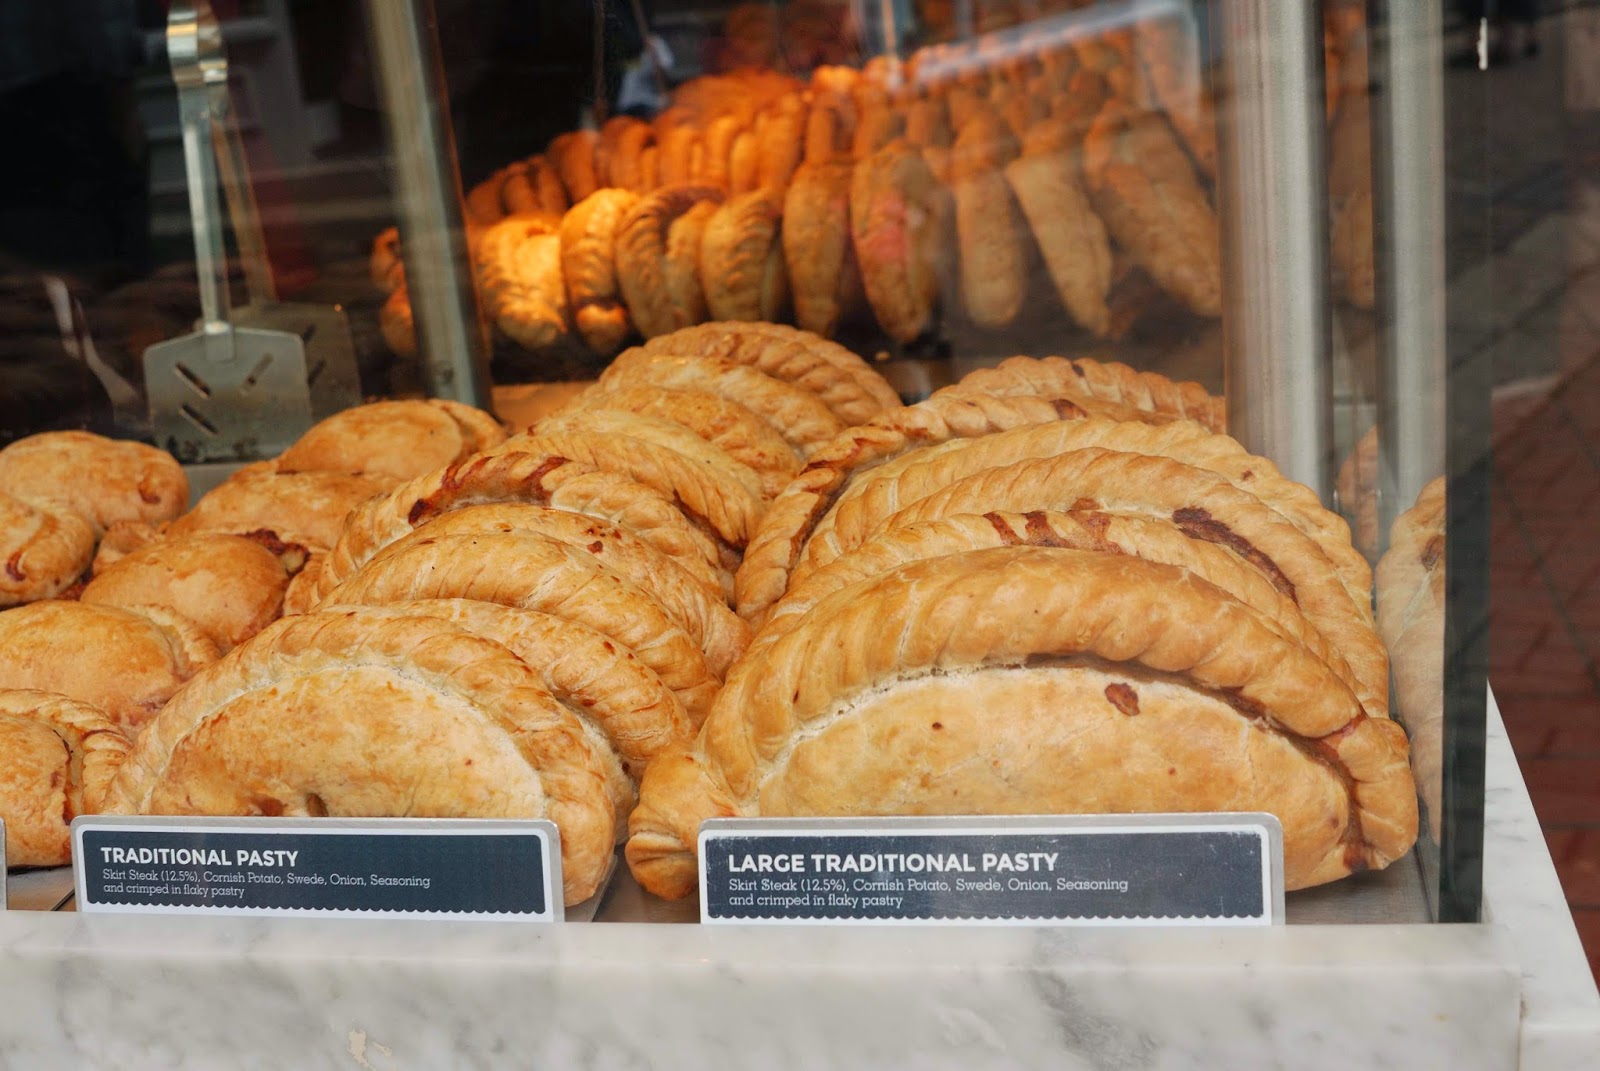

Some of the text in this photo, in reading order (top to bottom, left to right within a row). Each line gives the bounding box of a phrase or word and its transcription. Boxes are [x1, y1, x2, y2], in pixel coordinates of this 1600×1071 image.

[100, 847, 299, 867] TRADITIONAL PASTY
[728, 852, 1059, 873] LARGE TRADITIONAL PASTY
[103, 869, 431, 889] Skirt Steak (12.5%), Cornish Potato, Swede, Onion, Seasoning
[729, 877, 1129, 893] Skirt Steak (12.5%), Cornish Potato, Swede, Onion, Seasoning
[103, 883, 245, 899] and crimped in flaky pastry
[729, 894, 903, 909] and crimped in flaky pastry
